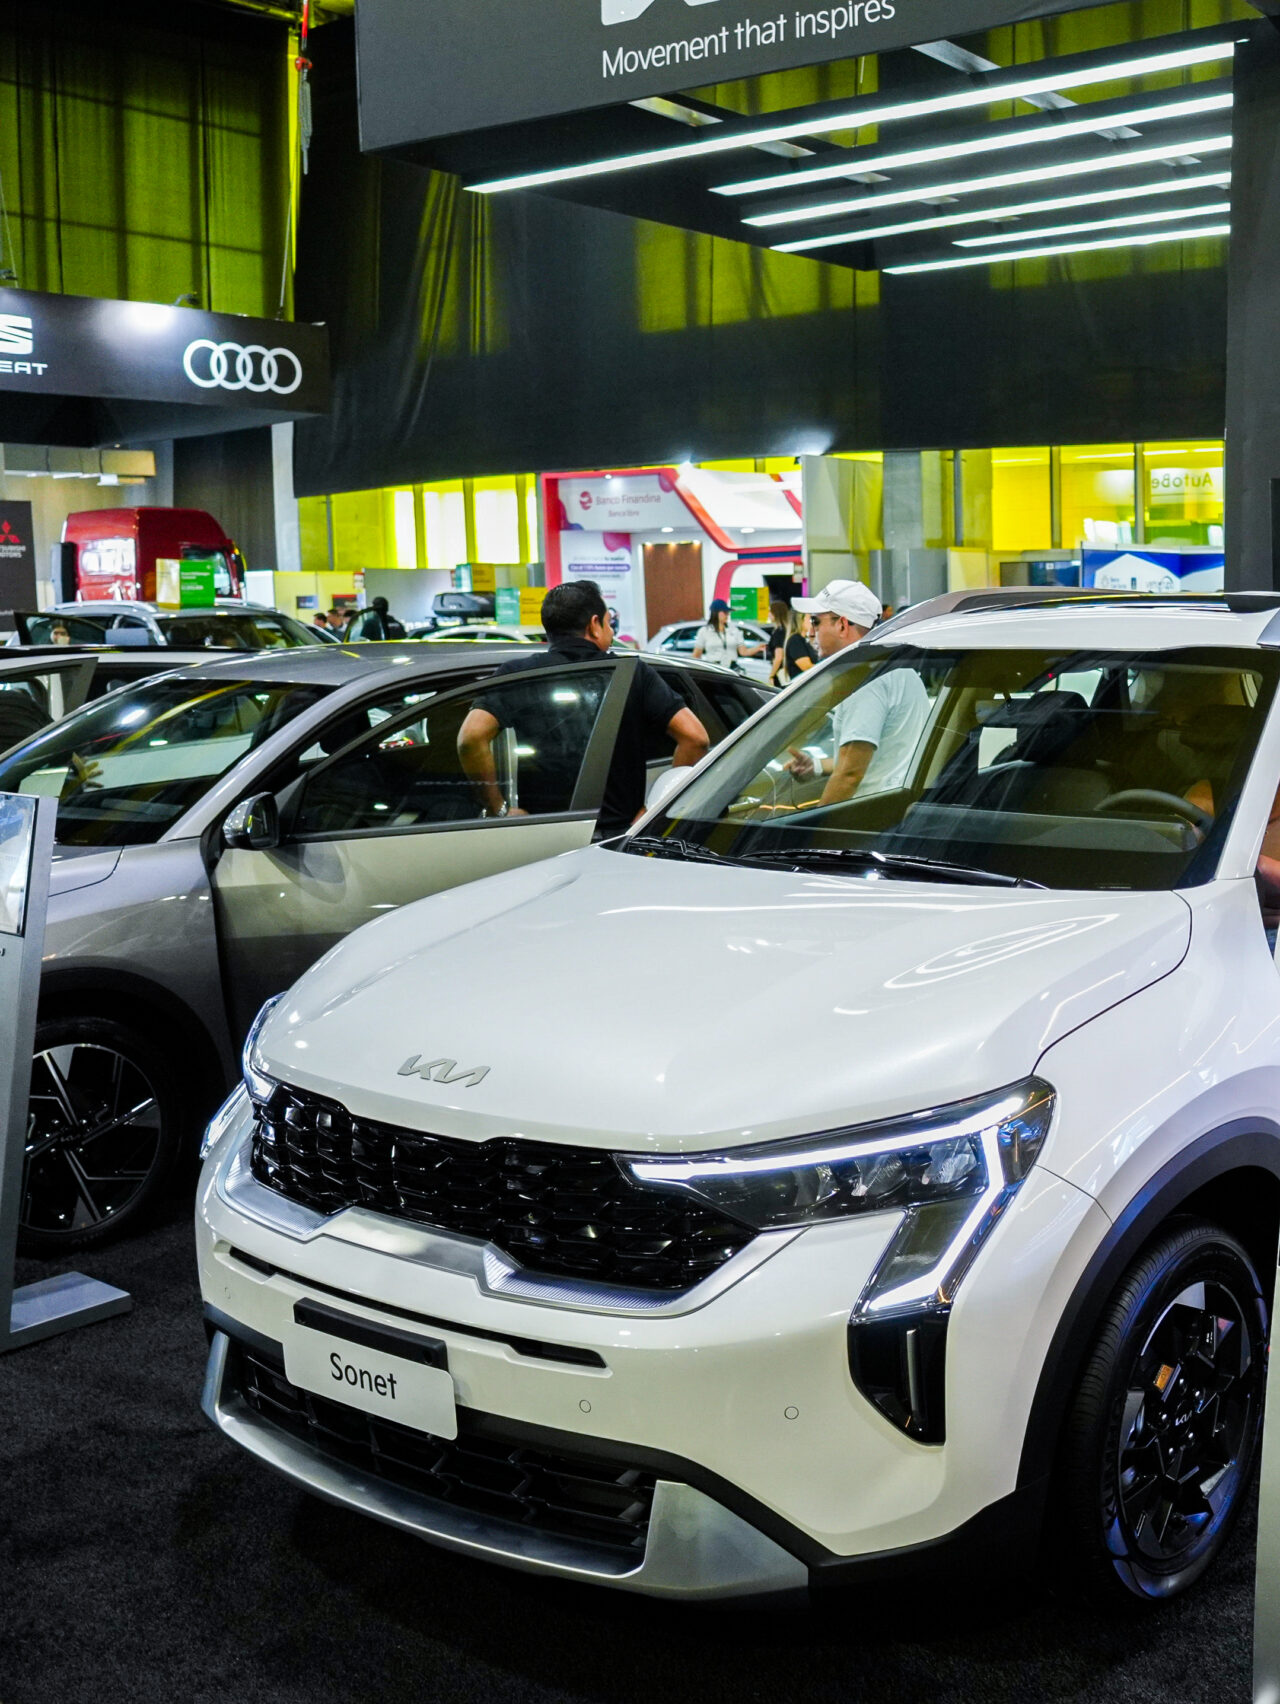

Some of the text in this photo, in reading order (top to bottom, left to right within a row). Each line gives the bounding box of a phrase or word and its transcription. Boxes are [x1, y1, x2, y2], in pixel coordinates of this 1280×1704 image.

[602, 0, 896, 78] Movement that inspires
[397, 1054, 491, 1088] KIA
[330, 1352, 398, 1400] Sonet
